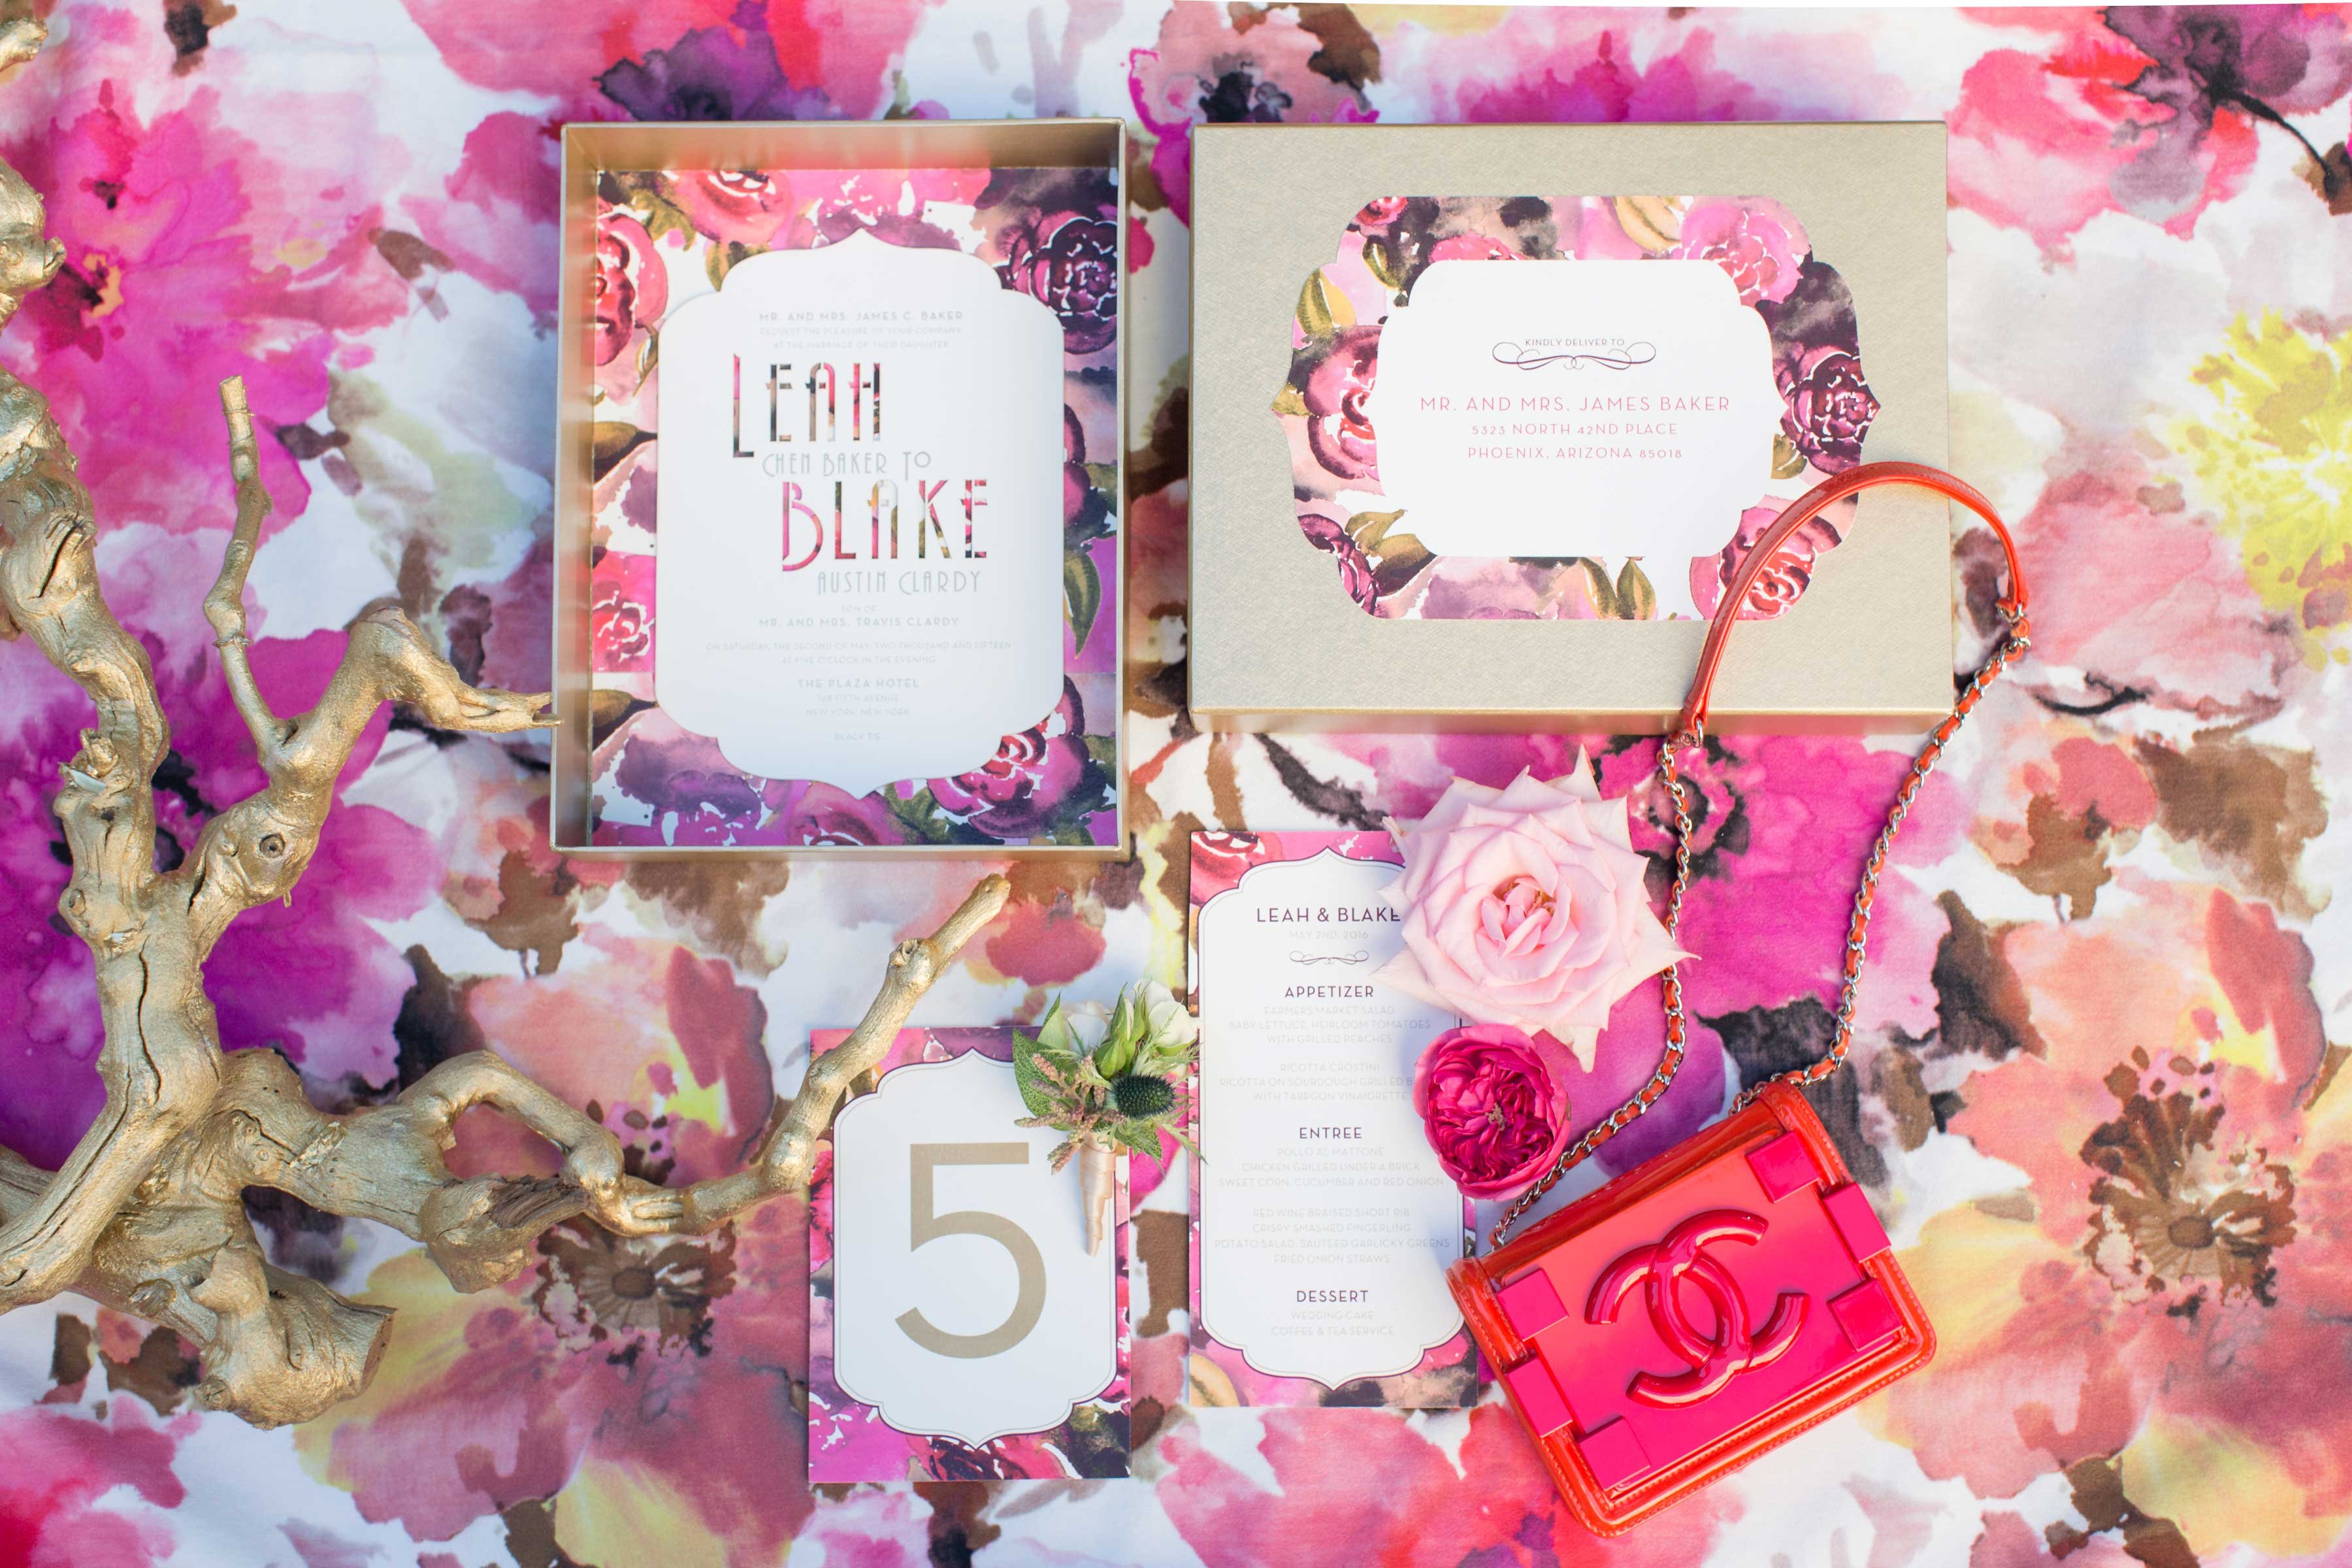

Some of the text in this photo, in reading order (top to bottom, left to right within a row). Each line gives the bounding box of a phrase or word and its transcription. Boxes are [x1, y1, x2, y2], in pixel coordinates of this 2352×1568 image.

[759, 312, 781, 321] MR.
[787, 312, 815, 321] AND
[819, 312, 847, 321] MRS.
[856, 312, 898, 321] JAMES
[921, 312, 963, 321] BAKER
[804, 327, 821, 336] THE
[786, 340, 804, 350] THE
[1525, 338, 1625, 347] KINDLY DELIVER TO
[732, 353, 882, 459] LEAH
[1420, 396, 1730, 412] MR. AND MRS. JAMES BAKER
[1471, 423, 1678, 436] 5323 NORTH 42ND PLACE
[1556, 447, 1632, 460] ARIZONA
[1639, 447, 1682, 460] 85018
[762, 451, 932, 482] CHEN BAKER TO
[781, 478, 989, 572] BLAKE
[817, 570, 981, 596] AUSTIN CLARDY
[758, 617, 959, 627] MR. AND MRS. TRAVIS CLARDY
[706, 642, 721, 651] ON
[774, 642, 791, 651] THE
[793, 642, 832, 651] SECOND
[874, 642, 896, 651] TWO
[899, 642, 950, 651] THOUSAND
[953, 642, 972, 651] AND
[974, 642, 1013, 651] FIFTEEN
[862, 655, 872, 664] IN
[874, 655, 892, 664] THE
[894, 655, 936, 664] EVENING
[797, 678, 919, 689] THE PLAZA HOTEL
[834, 694, 859, 703] FIFTH
[862, 694, 899, 703] AVENUE
[834, 732, 881, 742] BLACK TIE
[1256, 907, 1401, 923] LEAH & BLAKE
[1289, 930, 1313, 940] MAY
[1343, 930, 1369, 940] 2016
[1284, 985, 1374, 998] APPETIZER
[1264, 1005, 1396, 1015] FARMERS MARKET SALAD
[1228, 1020, 1256, 1030] BABY
[1311, 1020, 1369, 1030] HEIRLOOM
[1370, 1020, 1431, 1030] TOMATOES
[1266, 1034, 1393, 1044] WITH GRILLED PEACHES
[1280, 1062, 1380, 1073] RICOTTA CROSTINI
[1219, 1077, 1267, 1087] RICOTTA
[1268, 1077, 1286, 1087] ON
[1288, 1077, 1357, 1087] SOURDOUGH
[1360, 1077, 1405, 1087] GRILLED
[1252, 1091, 1281, 1102] WITH
[1337, 1091, 1407, 1102] VINAIGRETTE
[1299, 1126, 1363, 1139] ENTREE
[1331, 1147, 1384, 1156] MATTONE
[1241, 1162, 1420, 1172] CHICKEN GRILLED UNDER A BRICK
[1218, 1177, 1255, 1188] SWEET
[1294, 1177, 1355, 1188] CUCUMBER
[1357, 1177, 1381, 1188] AND
[1382, 1177, 1405, 1188] RED
[1407, 1177, 1444, 1188] ONION
[1252, 1208, 1411, 1218] RED WINE BRAISED SHORT RIB
[1252, 1223, 1412, 1233] CRISPY SMASHED FINGERLING
[1214, 1238, 1259, 1249] POTATO
[1350, 1238, 1405, 1249] GARLICKY
[1406, 1238, 1450, 1249] GREENS
[895, 1142, 1047, 1359] 5
[1274, 1254, 1390, 1264] FRIED ONION STRAWS
[1296, 1290, 1369, 1303] DESSERT
[1291, 1311, 1375, 1320] WEDDING CAKE
[1270, 1326, 1395, 1336] COFFEE & TEA SERVICE
